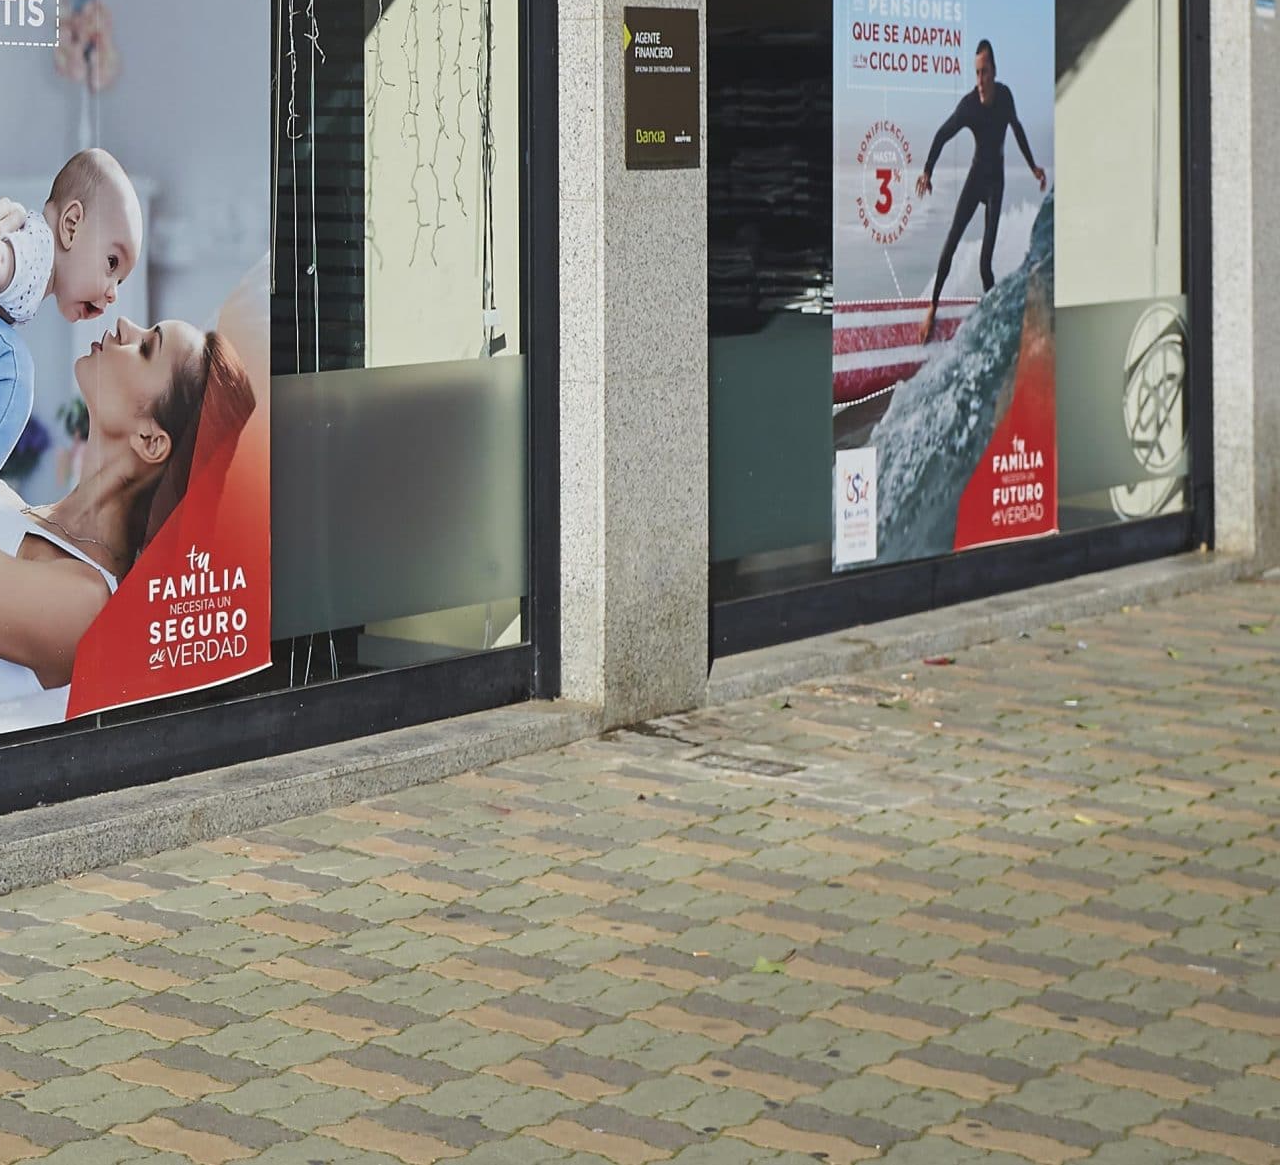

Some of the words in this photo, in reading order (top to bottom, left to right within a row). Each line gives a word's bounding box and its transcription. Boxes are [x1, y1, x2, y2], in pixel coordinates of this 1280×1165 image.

[635, 32, 661, 44] AGENTE
[852, 22, 880, 41] QUE
[884, 25, 899, 43] SE
[903, 25, 961, 47] ADAPTAN
[635, 47, 673, 59] FINANCIERO
[869, 51, 908, 72] CICLO
[912, 54, 929, 73] DE
[931, 55, 961, 75] VIDA
[636, 129, 666, 143] Bankia
[873, 151, 897, 163] HASTA
[992, 450, 1044, 474] FAMILIA
[992, 482, 1044, 507] FUTURO
[1000, 502, 1044, 526] VERDAD
[149, 566, 247, 602] FAMILIA
[170, 598, 215, 615] NECESITA
[217, 596, 231, 608] UN
[149, 608, 247, 645] SEGURO
[167, 634, 248, 668] VERDAD
